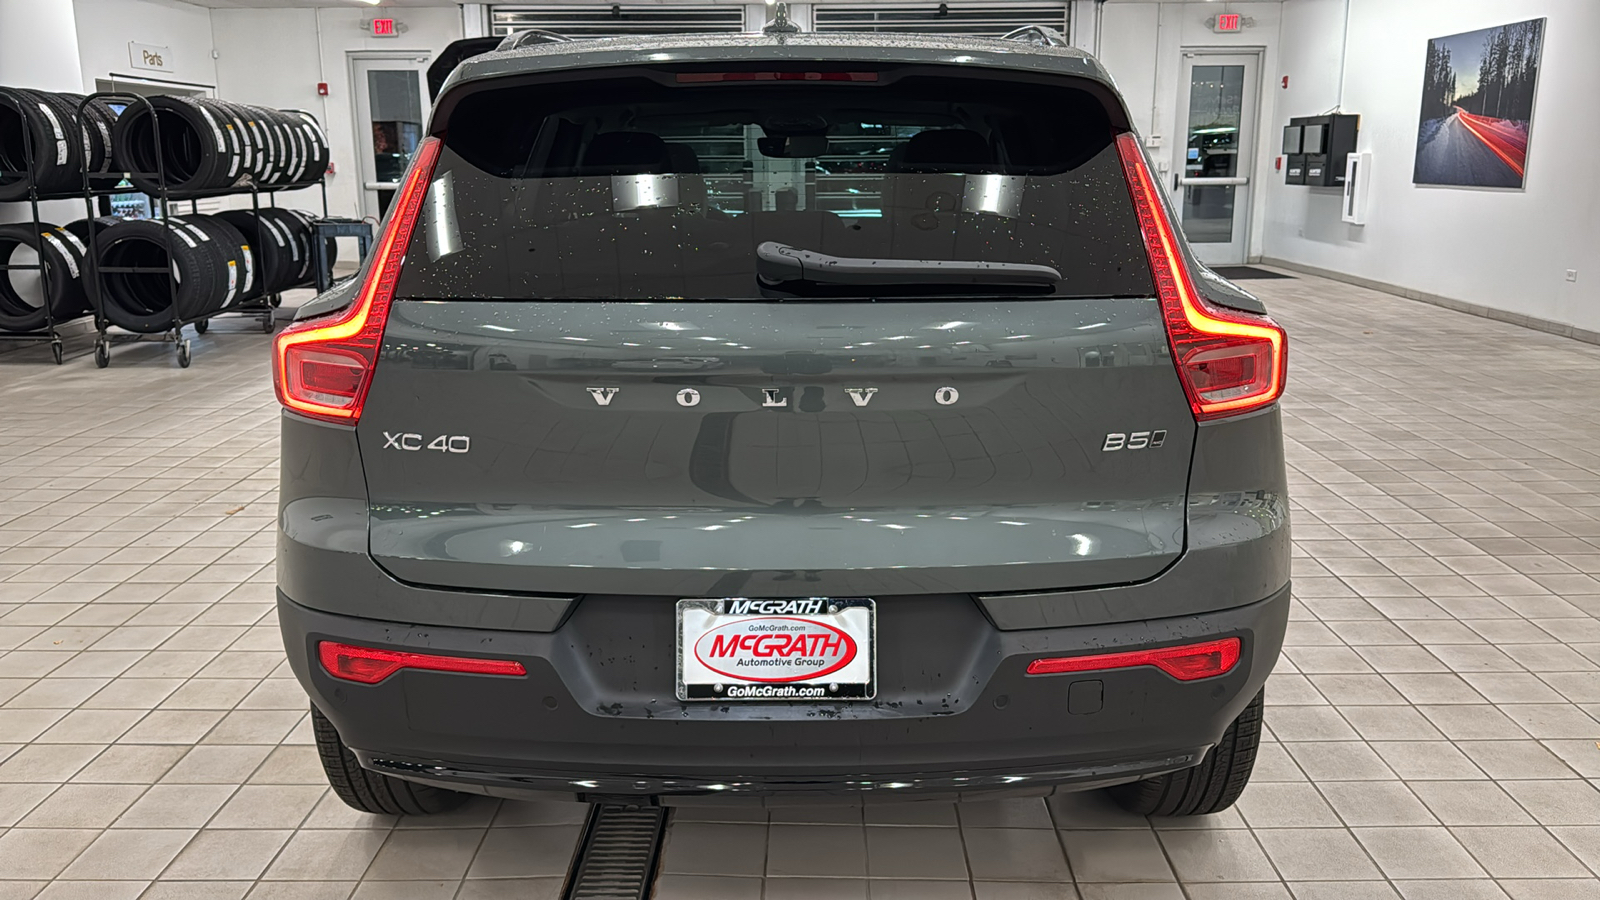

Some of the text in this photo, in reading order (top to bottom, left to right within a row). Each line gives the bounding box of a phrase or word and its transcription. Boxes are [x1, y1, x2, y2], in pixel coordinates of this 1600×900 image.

[373, 19, 393, 35] EXIT
[1219, 14, 1239, 30] EXIT
[142, 49, 164, 67] Parts
[586, 386, 960, 407] VOLVO
[1102, 431, 1151, 452] B5
[748, 624, 806, 633] GoMcGrath.com
[736, 658, 825, 669] Automotive Group
[727, 686, 825, 697] GoMcGrath.com
